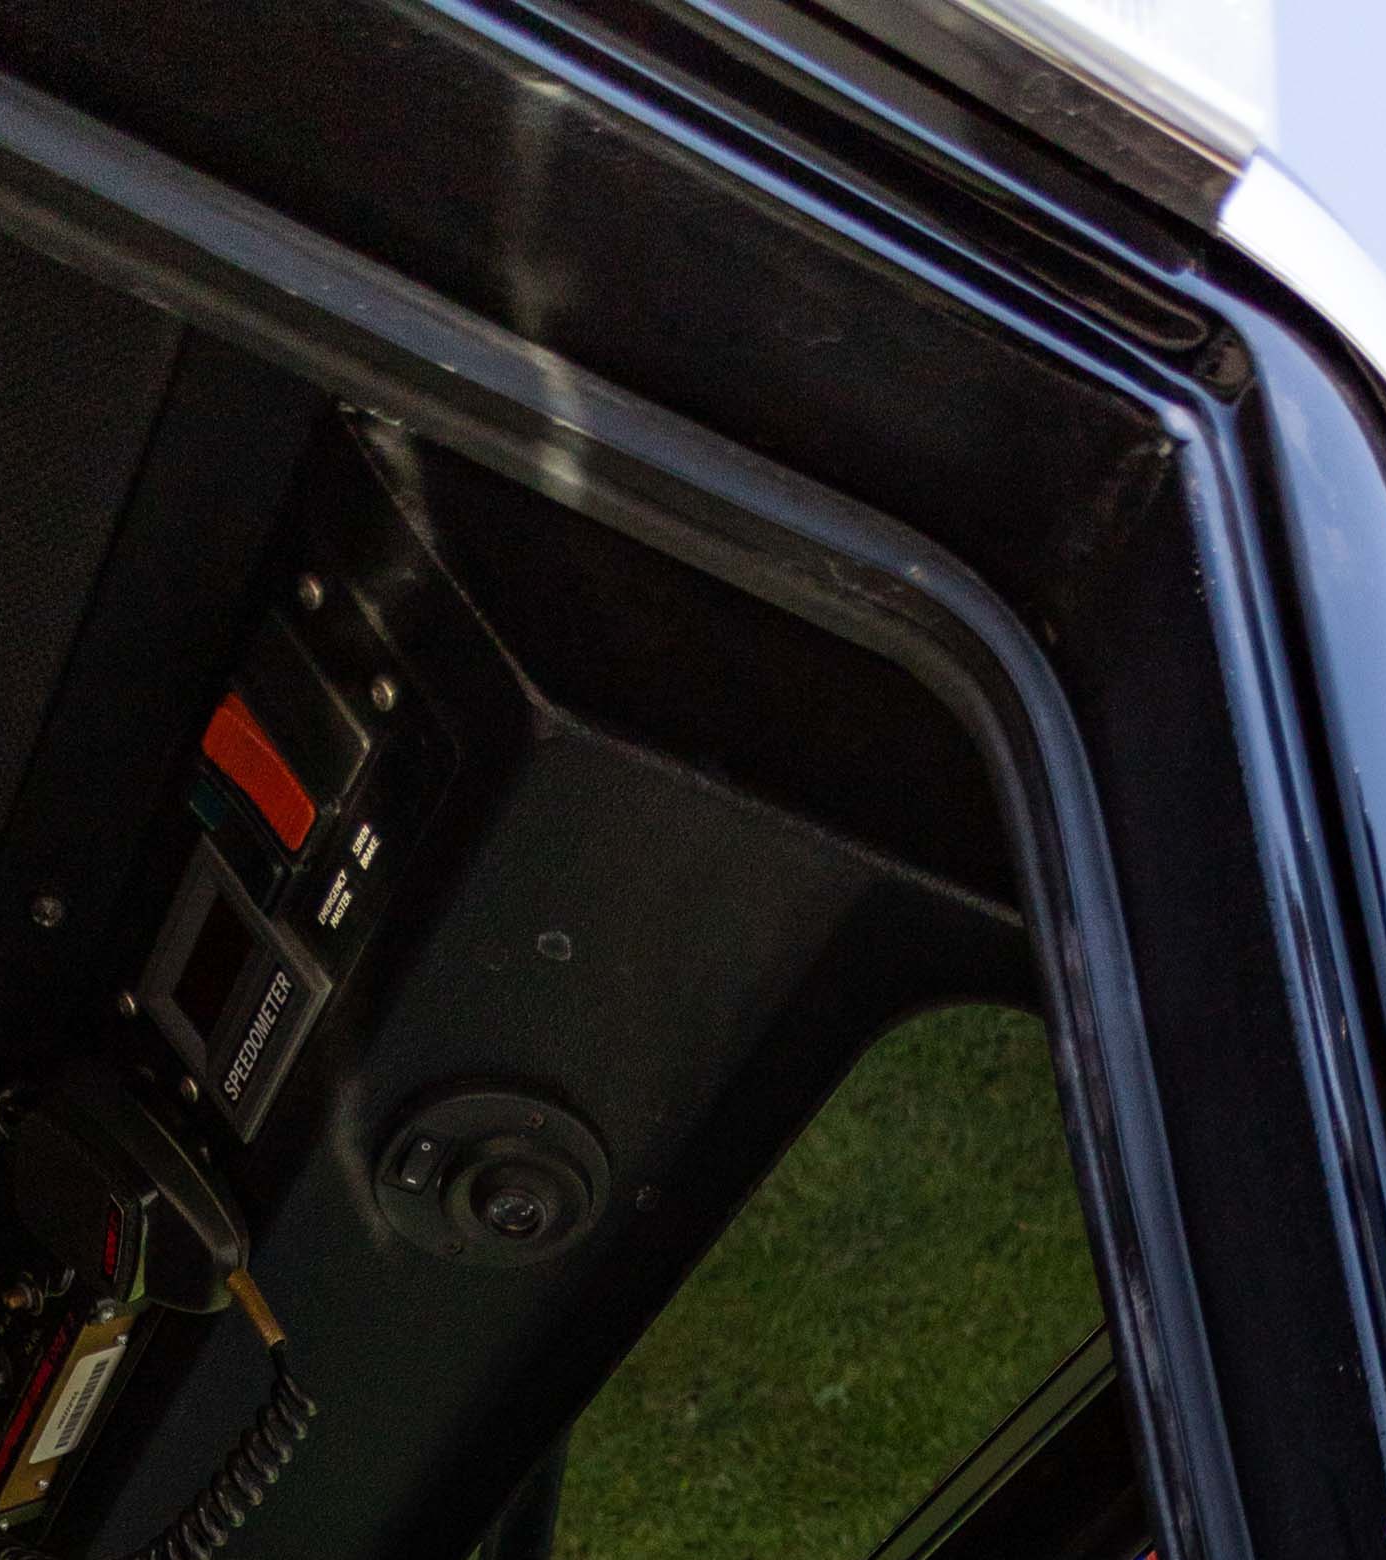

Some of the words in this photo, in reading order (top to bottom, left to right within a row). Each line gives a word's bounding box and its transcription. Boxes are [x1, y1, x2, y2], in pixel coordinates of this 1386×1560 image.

[318, 868, 347, 926] EMERGENCY
[330, 890, 352, 929] MASTER
[224, 971, 292, 1101] SPEEDOMETER
